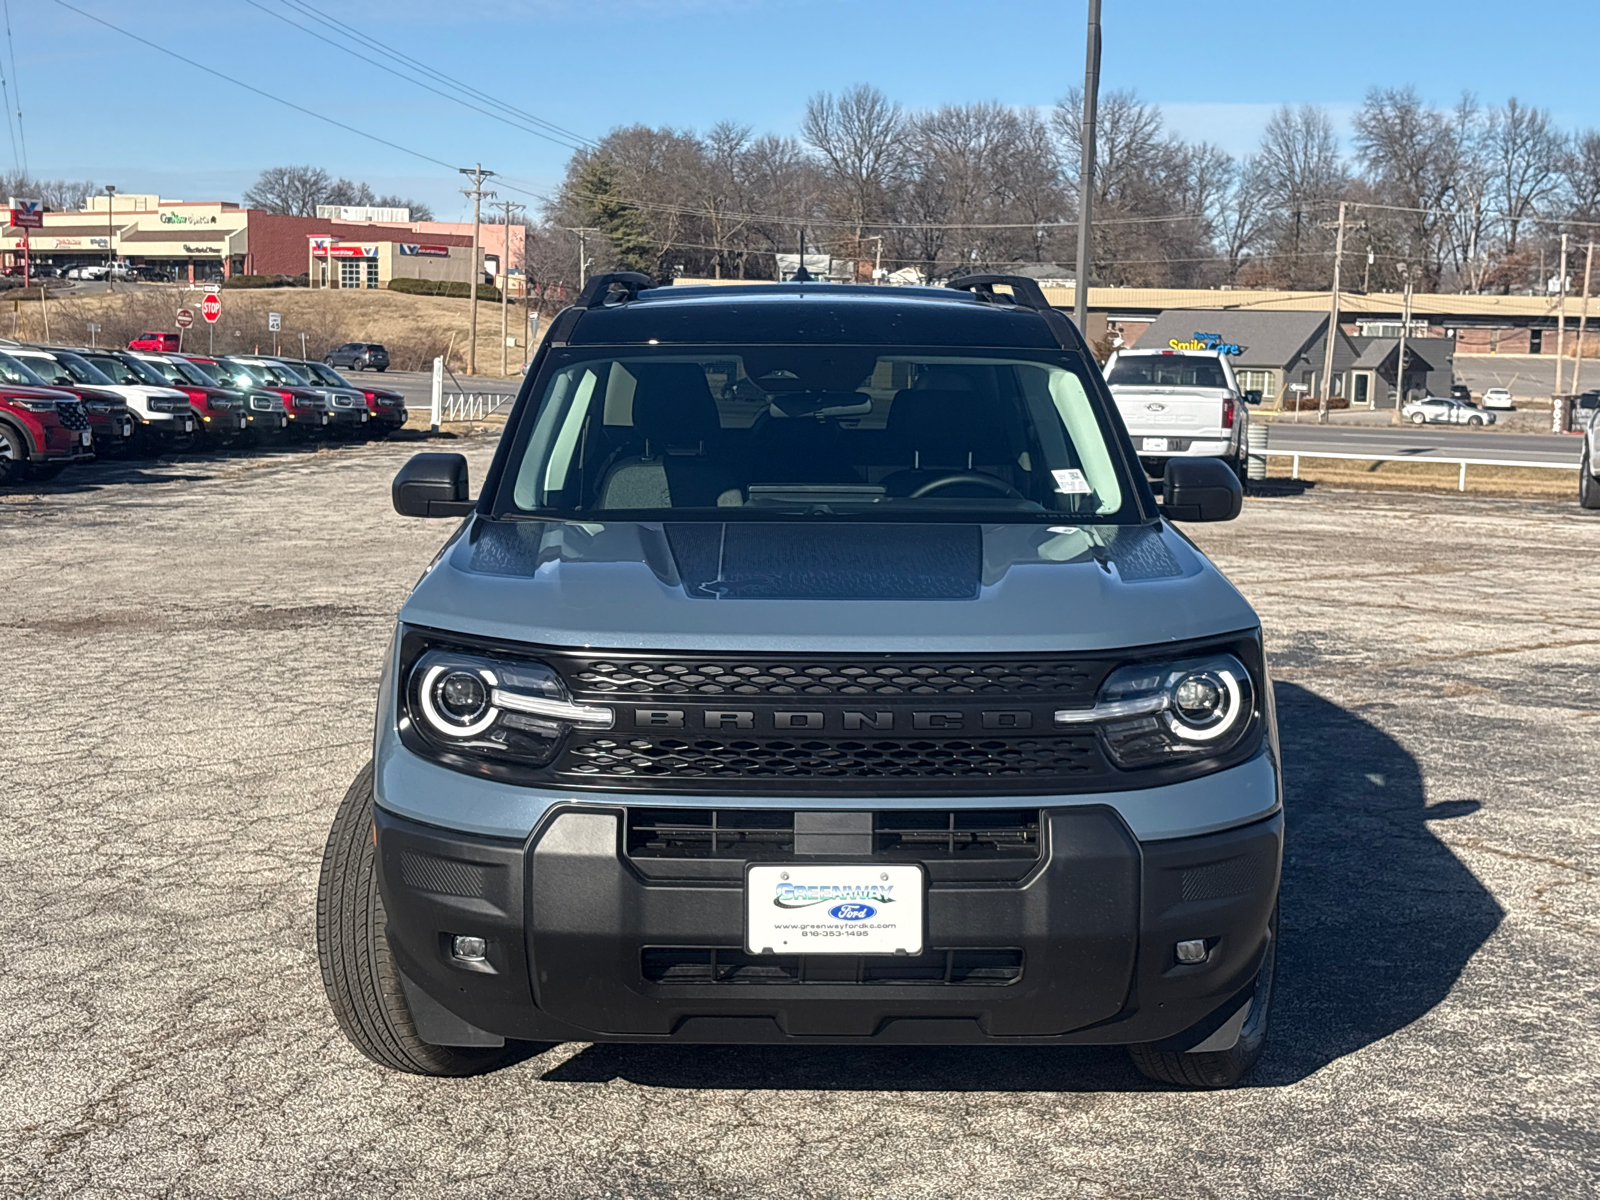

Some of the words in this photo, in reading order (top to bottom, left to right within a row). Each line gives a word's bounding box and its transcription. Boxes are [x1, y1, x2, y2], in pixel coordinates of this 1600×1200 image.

[204, 302, 220, 314] STOP
[1207, 339, 1239, 355] Care
[635, 708, 1033, 730] BRONCO
[776, 882, 894, 901] GREENWAY
[838, 905, 867, 919] Ford
